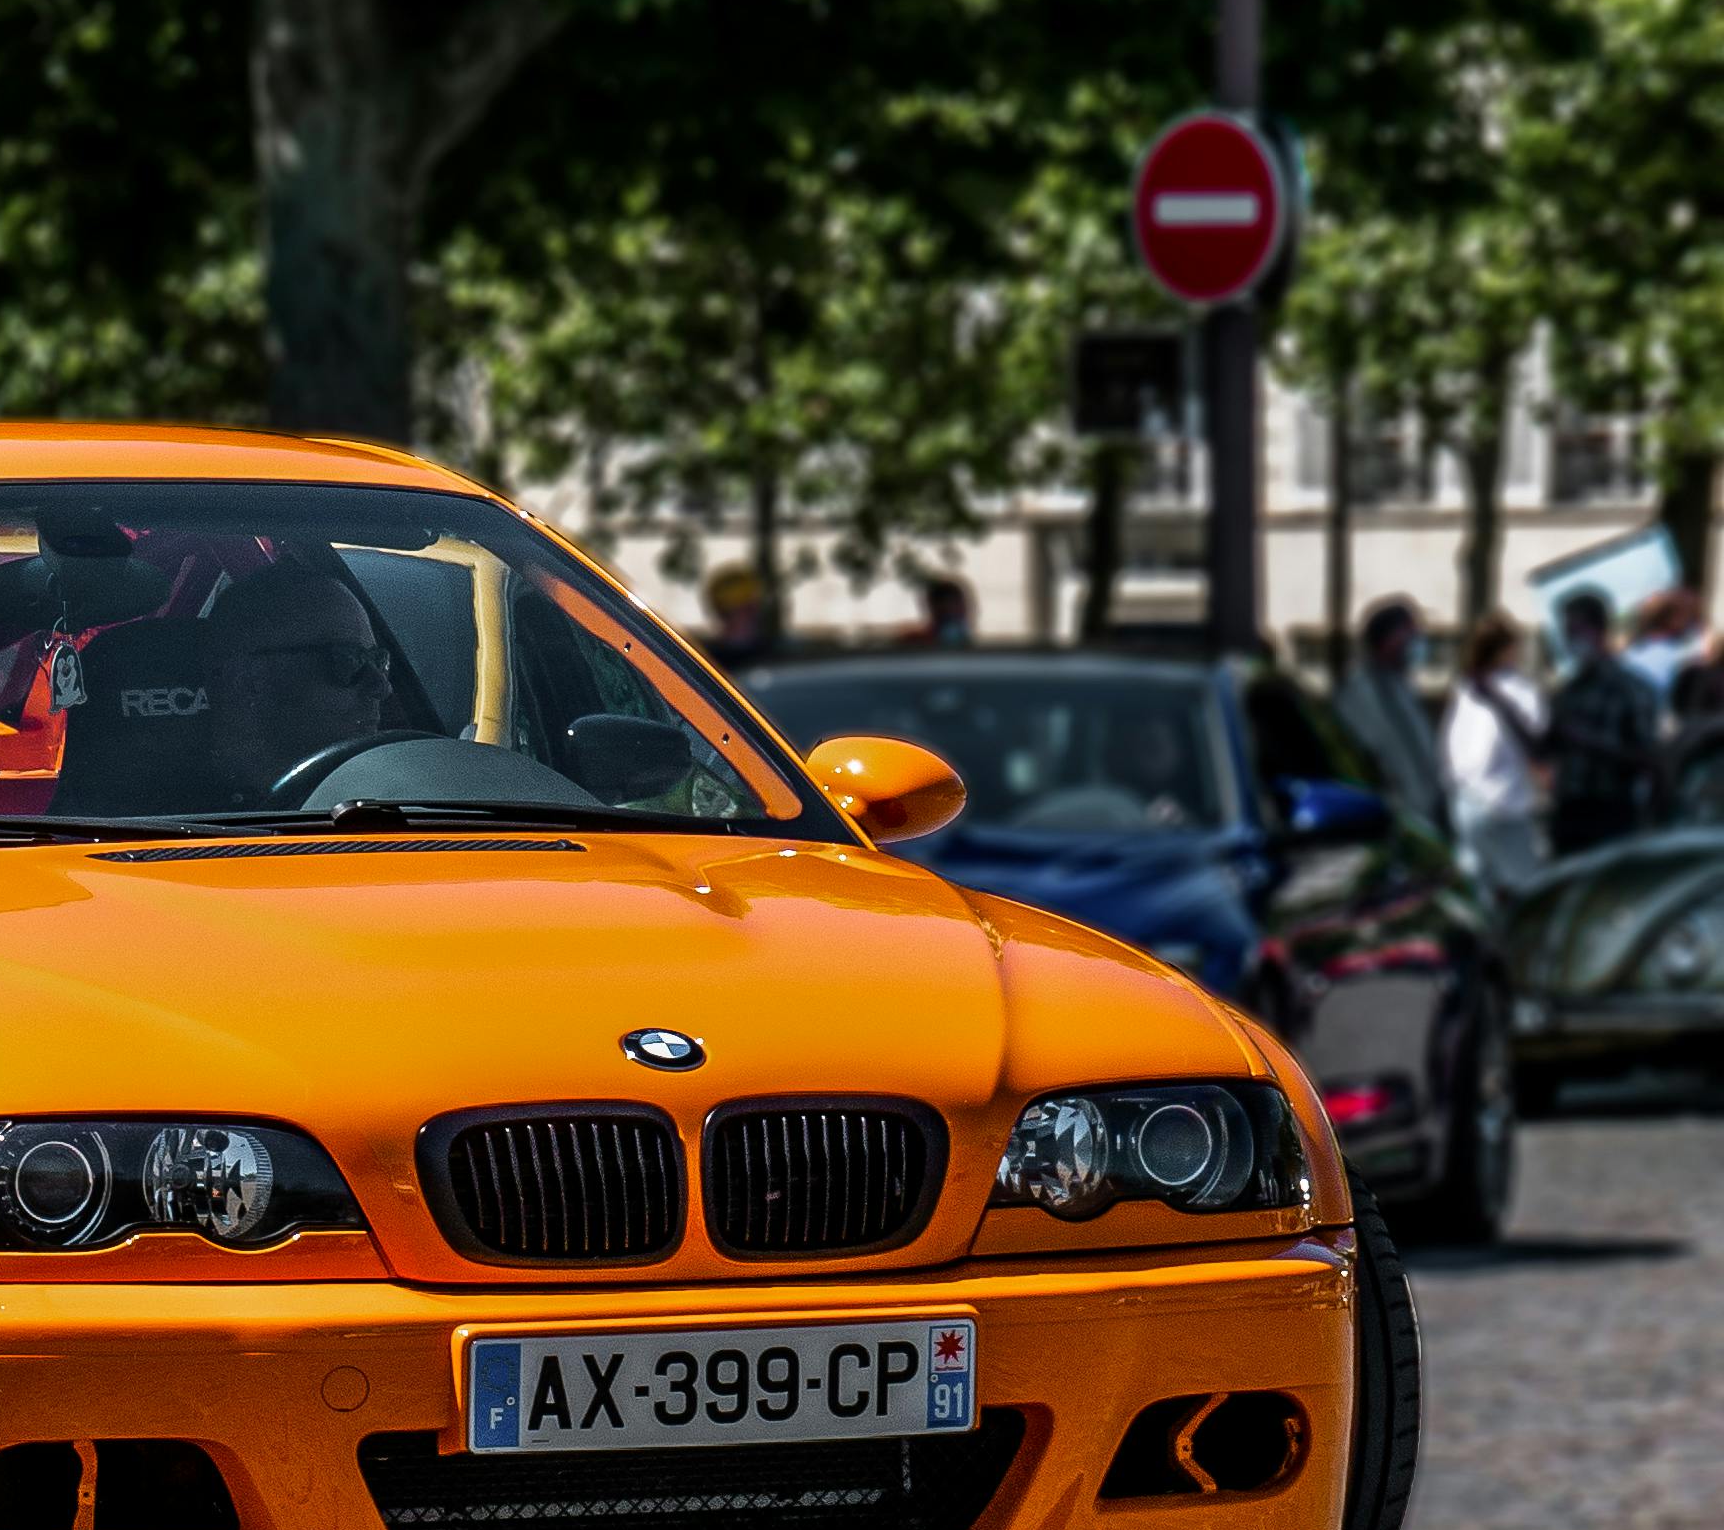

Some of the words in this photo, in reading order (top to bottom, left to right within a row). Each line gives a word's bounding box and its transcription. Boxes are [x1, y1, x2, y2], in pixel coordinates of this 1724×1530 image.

[489, 1407, 504, 1430] F
[527, 1341, 919, 1430] AX-399-CP
[934, 1382, 964, 1419] 91
